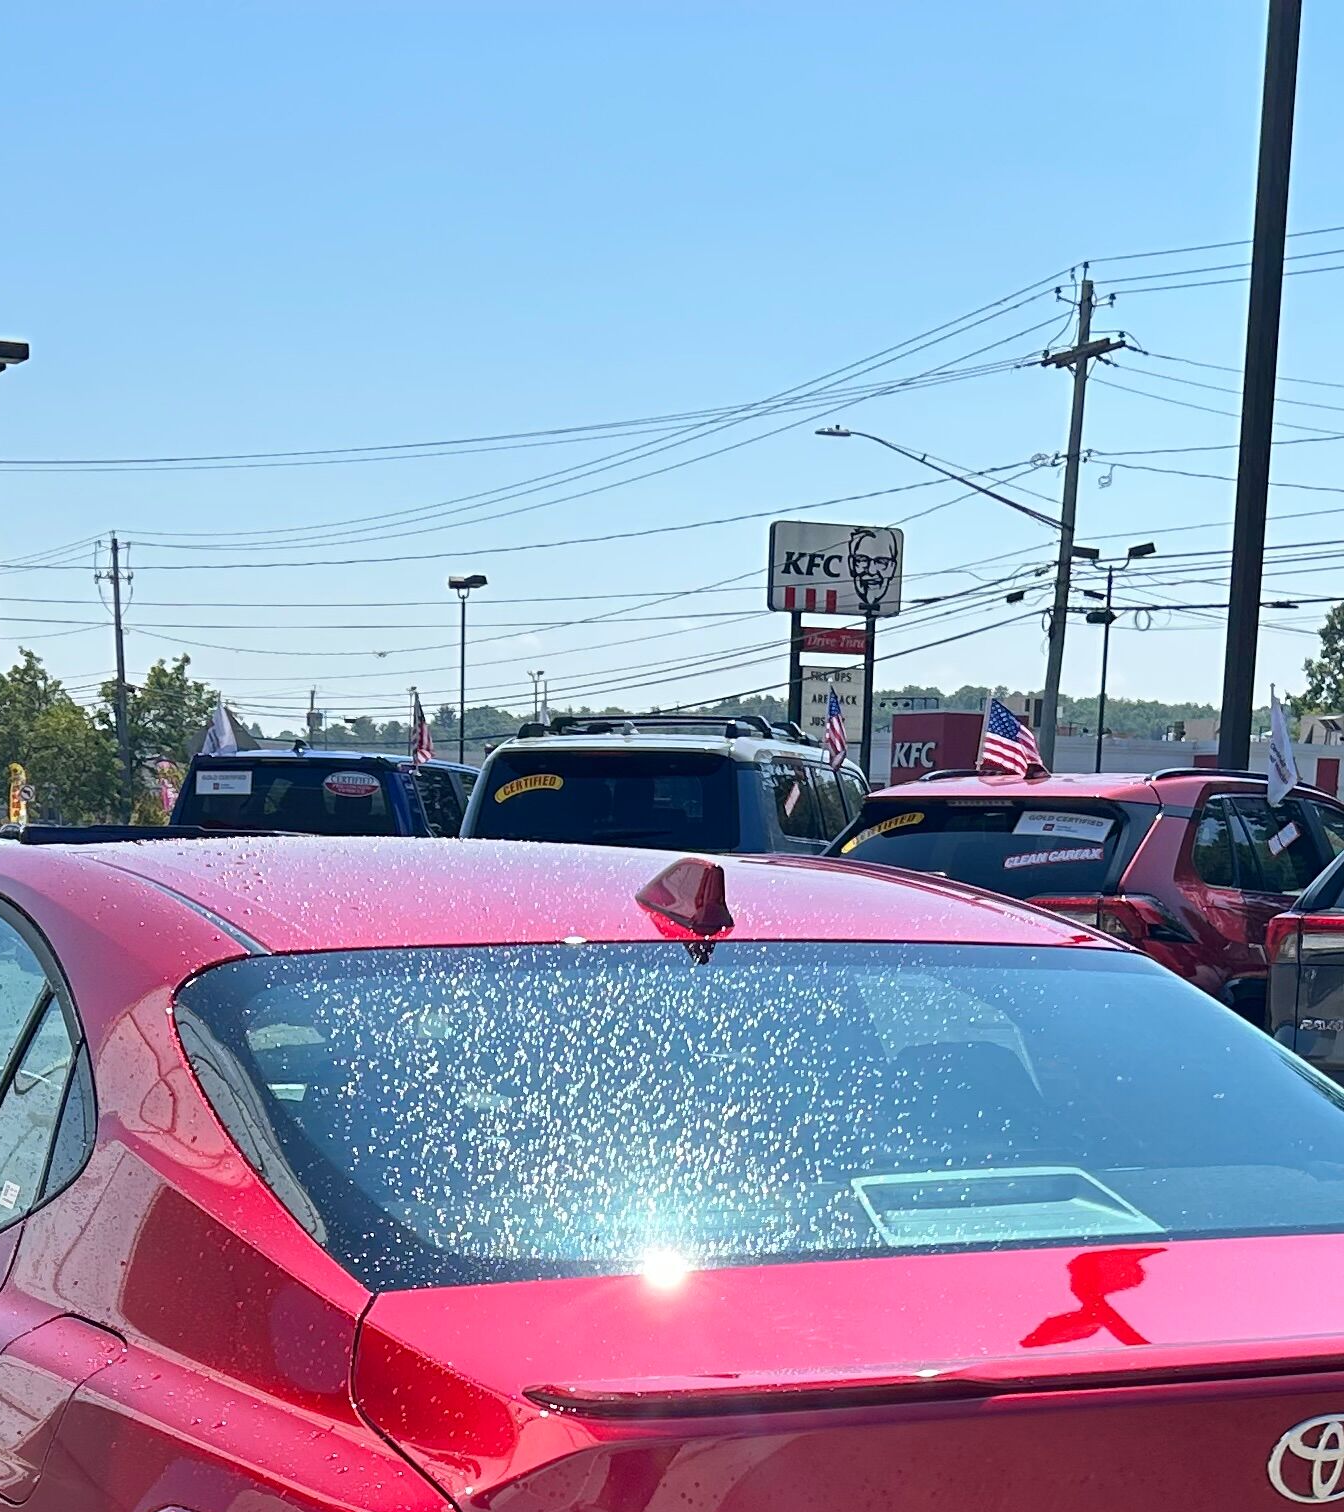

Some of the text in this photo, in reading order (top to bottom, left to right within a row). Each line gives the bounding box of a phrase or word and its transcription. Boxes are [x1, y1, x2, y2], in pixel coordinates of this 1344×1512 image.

[781, 552, 843, 577] KFC
[834, 672, 852, 682] UPS
[809, 717, 825, 726] JUS
[892, 741, 936, 768] KFC
[503, 776, 556, 796] CERTIFIED
[1004, 847, 1103, 869] CLEAN CARFAX
